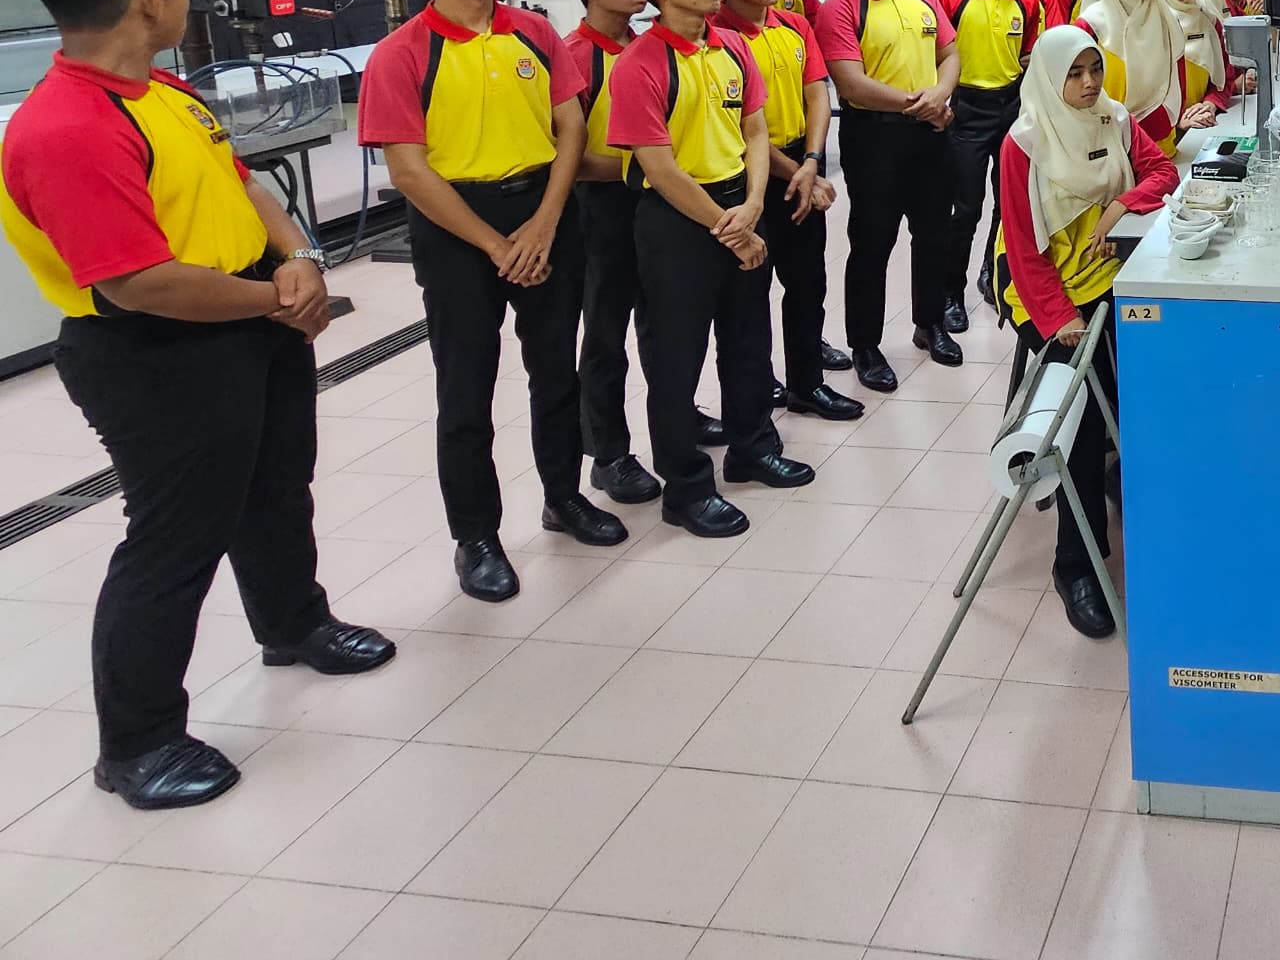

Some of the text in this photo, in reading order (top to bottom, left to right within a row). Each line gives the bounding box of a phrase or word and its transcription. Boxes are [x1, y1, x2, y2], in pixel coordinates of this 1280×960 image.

[276, 2, 292, 10] OFF
[1127, 308, 1152, 319] A 2
[1172, 669, 1264, 682] ACCESSORIES FOR
[1173, 679, 1237, 690] VISCOMETER
